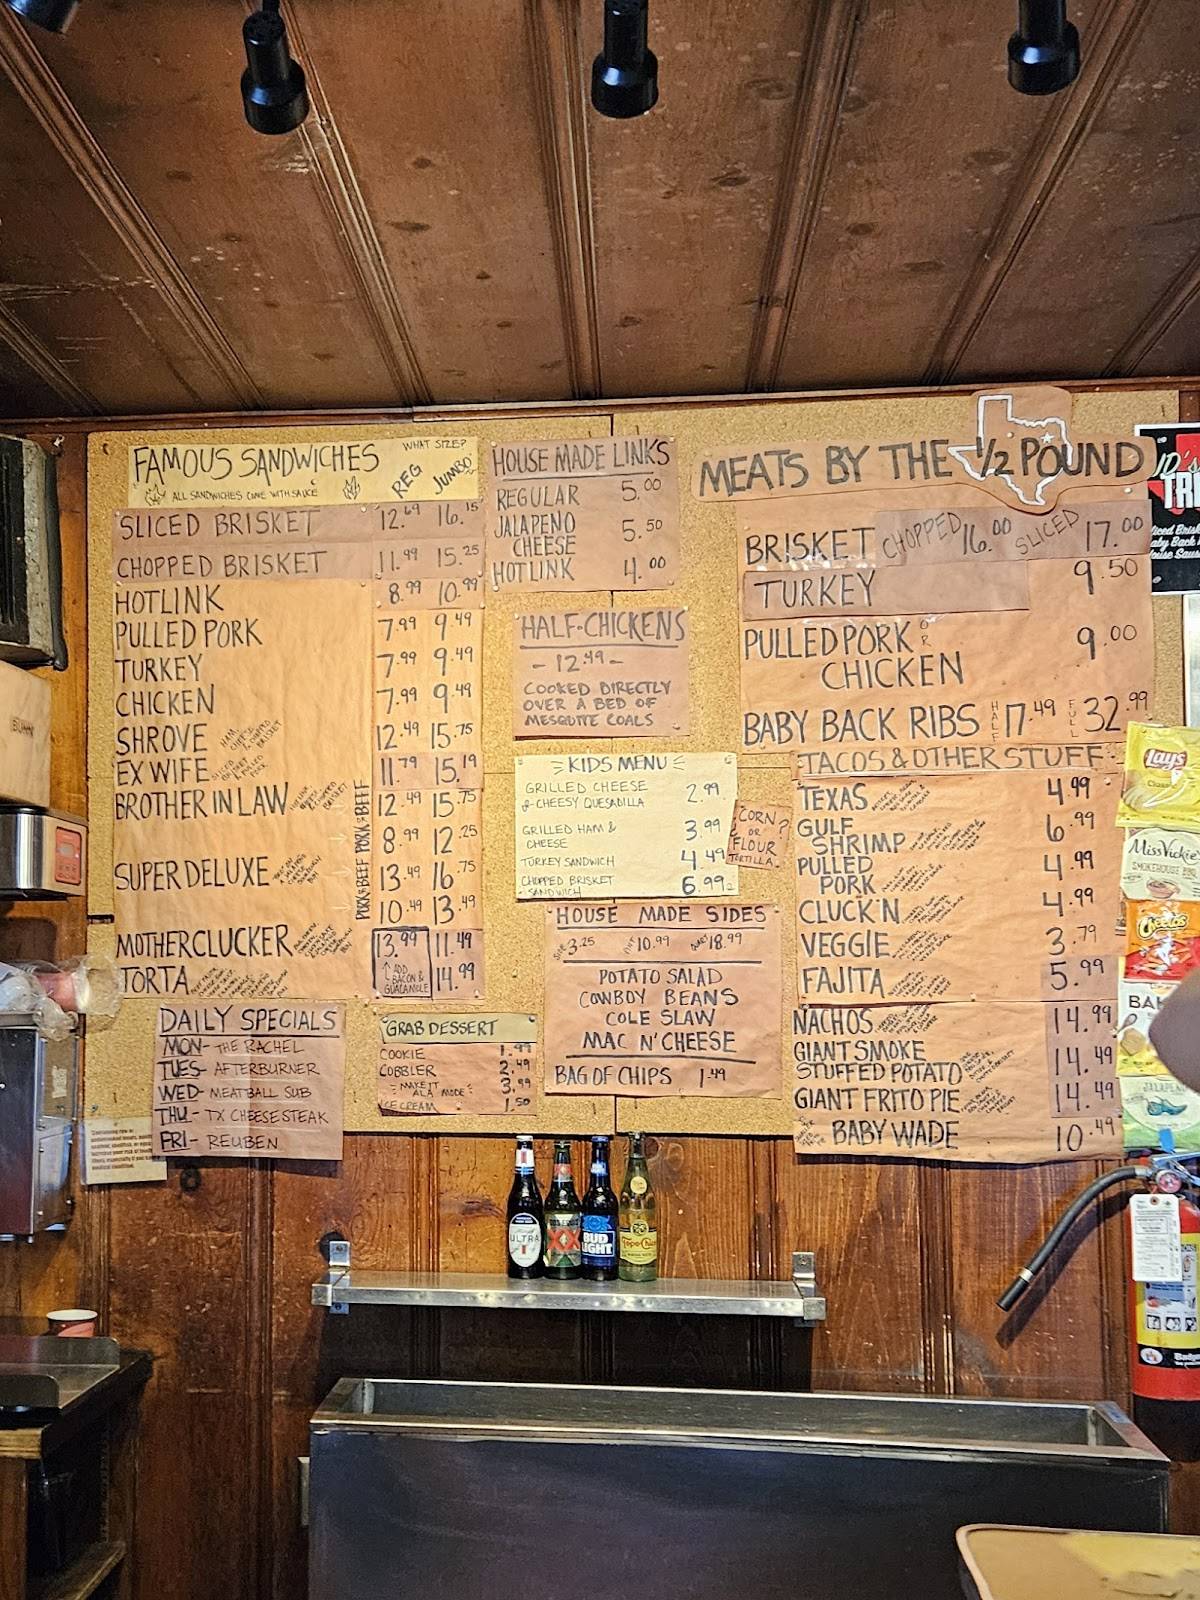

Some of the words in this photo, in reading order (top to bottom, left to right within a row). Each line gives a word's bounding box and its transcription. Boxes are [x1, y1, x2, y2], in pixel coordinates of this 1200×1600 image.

[402, 441, 429, 451] WHAT
[134, 446, 233, 485] FAMOUS
[239, 443, 380, 486] SANDWICHES
[493, 447, 549, 476] HOUSE
[556, 444, 605, 472] MADE
[614, 439, 670, 467] LINKS
[700, 450, 809, 496] MEATS
[825, 445, 870, 484] BY
[879, 439, 953, 480] THE
[1021, 437, 1144, 477] POUND
[391, 464, 423, 499] REG
[433, 456, 473, 495] JUMBO
[172, 491, 188, 502] ALL
[190, 491, 242, 500] SANDWICHES
[497, 485, 580, 511] REGULAR
[120, 514, 200, 540] SLICED
[215, 509, 320, 537] BRISKET
[494, 511, 575, 538] JALAPENO
[513, 536, 576, 557] CHEESE
[746, 527, 875, 565] BRISKET
[882, 512, 962, 559] CHOPPED
[1016, 510, 1079, 555] SLICED
[117, 555, 213, 578] CHOPPED
[224, 551, 327, 577] BRISKET
[754, 570, 875, 609] TURKEY
[116, 620, 196, 649] PULLED
[204, 618, 263, 647] PORK
[745, 627, 838, 660] PULLED
[844, 621, 914, 655] PORK
[115, 654, 202, 683] TURKEY
[822, 651, 964, 690] CHICKEN
[524, 682, 590, 695] COOKED
[600, 681, 671, 695] DIRECTLY
[116, 684, 215, 717] CHICKEN
[523, 699, 566, 712] OVER
[577, 699, 586, 710] A
[594, 698, 626, 710] BED
[636, 698, 656, 708] OF
[525, 714, 599, 727] MESQUITE
[607, 713, 653, 726] COALS
[744, 710, 808, 746] BABY
[822, 708, 897, 742] BACK
[910, 703, 980, 739] RIBS
[116, 723, 208, 755] SHROVE
[568, 756, 612, 773] KIDS
[618, 755, 667, 772] MENU
[800, 750, 885, 774] TACOS
[893, 747, 908, 769] &
[914, 747, 1000, 769] OTHER
[1005, 746, 1103, 769] STUFF
[117, 760, 143, 786] EX
[150, 758, 209, 785] WIFE
[526, 783, 587, 793] GRILLED
[593, 781, 648, 792] CHEESE
[115, 789, 208, 820] BROTHER
[213, 789, 233, 814] IN
[238, 782, 289, 816] LAW
[584, 798, 644, 809] QUESADILLA
[800, 783, 868, 811] TEXAS
[739, 808, 776, 825] CORN
[523, 824, 572, 835] GRILLED
[578, 824, 605, 833] HAM
[749, 828, 760, 837] OR
[797, 818, 853, 837] GULF
[527, 839, 568, 848] CHEESE
[732, 837, 777, 857] FLOUR
[812, 833, 905, 855] SHRIMP
[1129, 839, 1162, 856] Miss
[521, 856, 561, 868] TURKEY
[565, 856, 615, 867] SANDWICH
[729, 854, 773, 865] TORTILLA
[798, 856, 873, 875] PULLED
[114, 861, 181, 891] SUPER
[185, 856, 270, 888] DELUXE
[521, 876, 564, 886] CHOPPED
[569, 876, 615, 885] BRISKET
[528, 887, 581, 897] SANDWICH
[820, 874, 876, 895] PORK
[557, 907, 618, 924] HOUSE
[639, 906, 692, 924] MADE
[706, 906, 766, 923] SIDES
[1137, 915, 1188, 938] Cheetos
[116, 924, 293, 959] MOTHERCLUCKER
[801, 930, 890, 958] VEGGIE
[392, 972, 416, 983] BACON
[394, 965, 408, 974] ADD
[600, 968, 660, 985] POTATO
[666, 968, 722, 987] SALAD
[121, 965, 190, 994] TORTA
[385, 984, 429, 994] GUACAMOLE
[803, 967, 885, 998] FAJITA
[580, 989, 646, 1008] COWBOY
[665, 988, 739, 1006] BEANS
[160, 1005, 233, 1033] DAILY
[241, 1009, 337, 1031] SPECIALS
[606, 1010, 650, 1026] COLE
[661, 1009, 716, 1026] SLAW
[793, 1008, 873, 1035] NACHOS
[386, 1020, 424, 1037] GRAB
[429, 1019, 499, 1036] DESSERT
[216, 1041, 239, 1054] THE
[244, 1039, 304, 1054] RACHEL
[583, 1032, 627, 1049] MAC
[380, 1048, 425, 1060] COOKIE
[794, 1040, 851, 1062] GIANT
[855, 1040, 926, 1061] SMOKE
[214, 1062, 320, 1076] AFTERBURNER
[380, 1064, 437, 1077] COBBLER
[555, 1065, 587, 1085] BAG
[593, 1066, 611, 1085] OF
[618, 1067, 672, 1085] CHIPS
[797, 1063, 885, 1082] STUFFED
[891, 1062, 963, 1085] POTATO
[210, 1087, 278, 1098] MEATBALL
[285, 1086, 311, 1097] SUB
[400, 1082, 427, 1090] MAKE
[441, 1088, 464, 1096] MODE
[795, 1088, 859, 1109] GIANT
[864, 1088, 924, 1112] FRITO
[930, 1089, 960, 1113] PIE
[206, 1110, 225, 1121] TX
[231, 1111, 329, 1124] CHEESESTEAK
[207, 1136, 278, 1149] REUBEN
[832, 1119, 887, 1146] BABY
[891, 1120, 959, 1149] WADE
[510, 1233, 540, 1242] ULTRA
[584, 1232, 608, 1243] BUD
[623, 1237, 640, 1247] Topo
